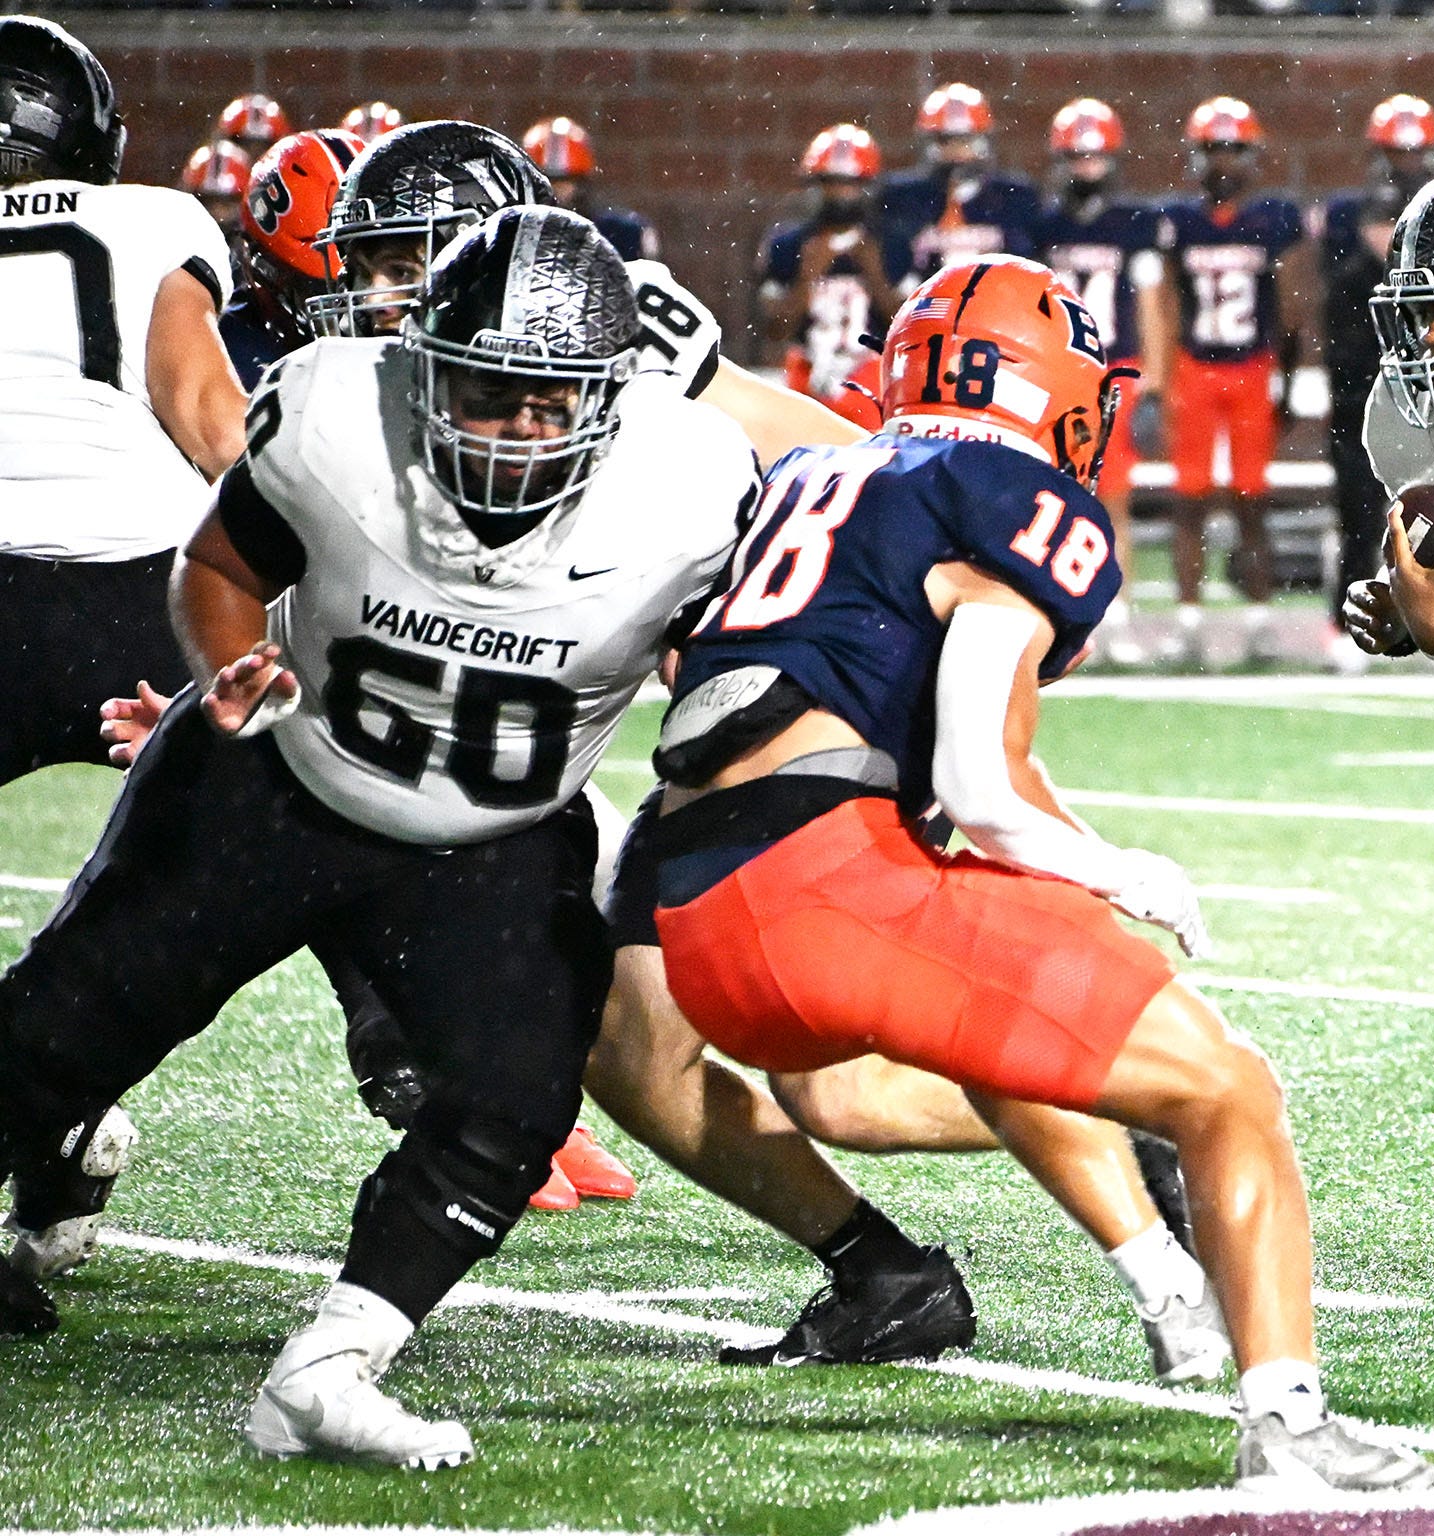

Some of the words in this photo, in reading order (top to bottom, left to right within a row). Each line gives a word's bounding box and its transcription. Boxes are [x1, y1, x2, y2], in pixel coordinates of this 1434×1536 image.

[3, 192, 80, 217] NON
[1193, 271, 1258, 343] 12
[920, 334, 999, 409] 18
[687, 447, 899, 637] 18
[1008, 488, 1110, 597] 18
[360, 594, 579, 668] VANDEGRIFT
[320, 634, 579, 811] 60
